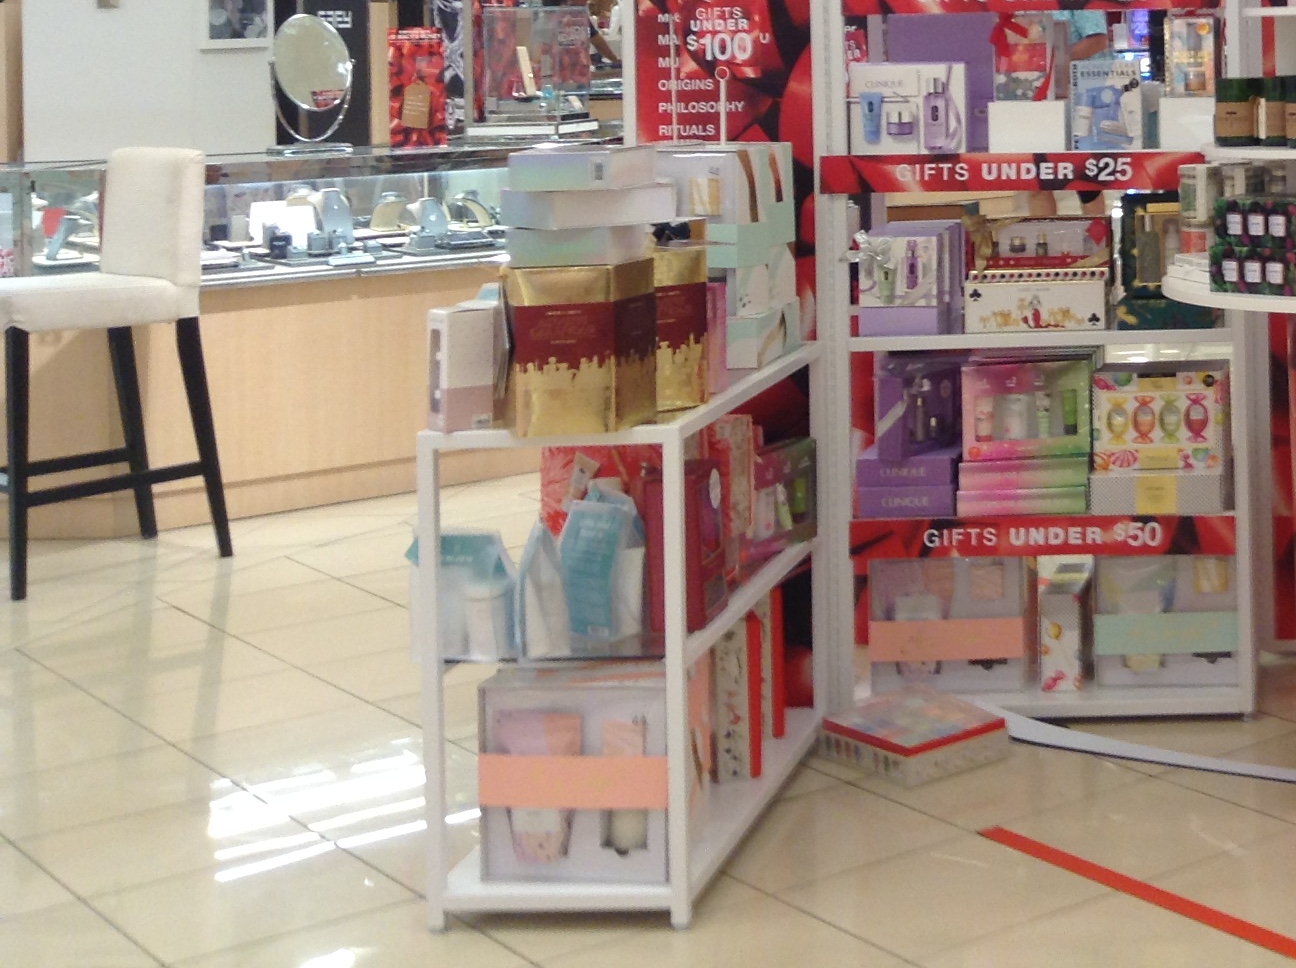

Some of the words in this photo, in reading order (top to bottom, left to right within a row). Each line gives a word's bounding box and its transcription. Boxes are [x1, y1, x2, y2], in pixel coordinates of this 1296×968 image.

[695, 7, 744, 19] GIFTS
[690, 18, 750, 32] UNDER
[686, 33, 752, 60] $100
[1080, 70, 1136, 78] ESSENTIALS
[658, 79, 715, 91] OIGINS
[896, 163, 970, 181] GIFTS
[981, 162, 1074, 180] UNDER
[1084, 157, 1133, 181] $25
[923, 528, 998, 548] GIFTS
[1009, 526, 1102, 547] UNDER
[1113, 522, 1162, 548] $50
